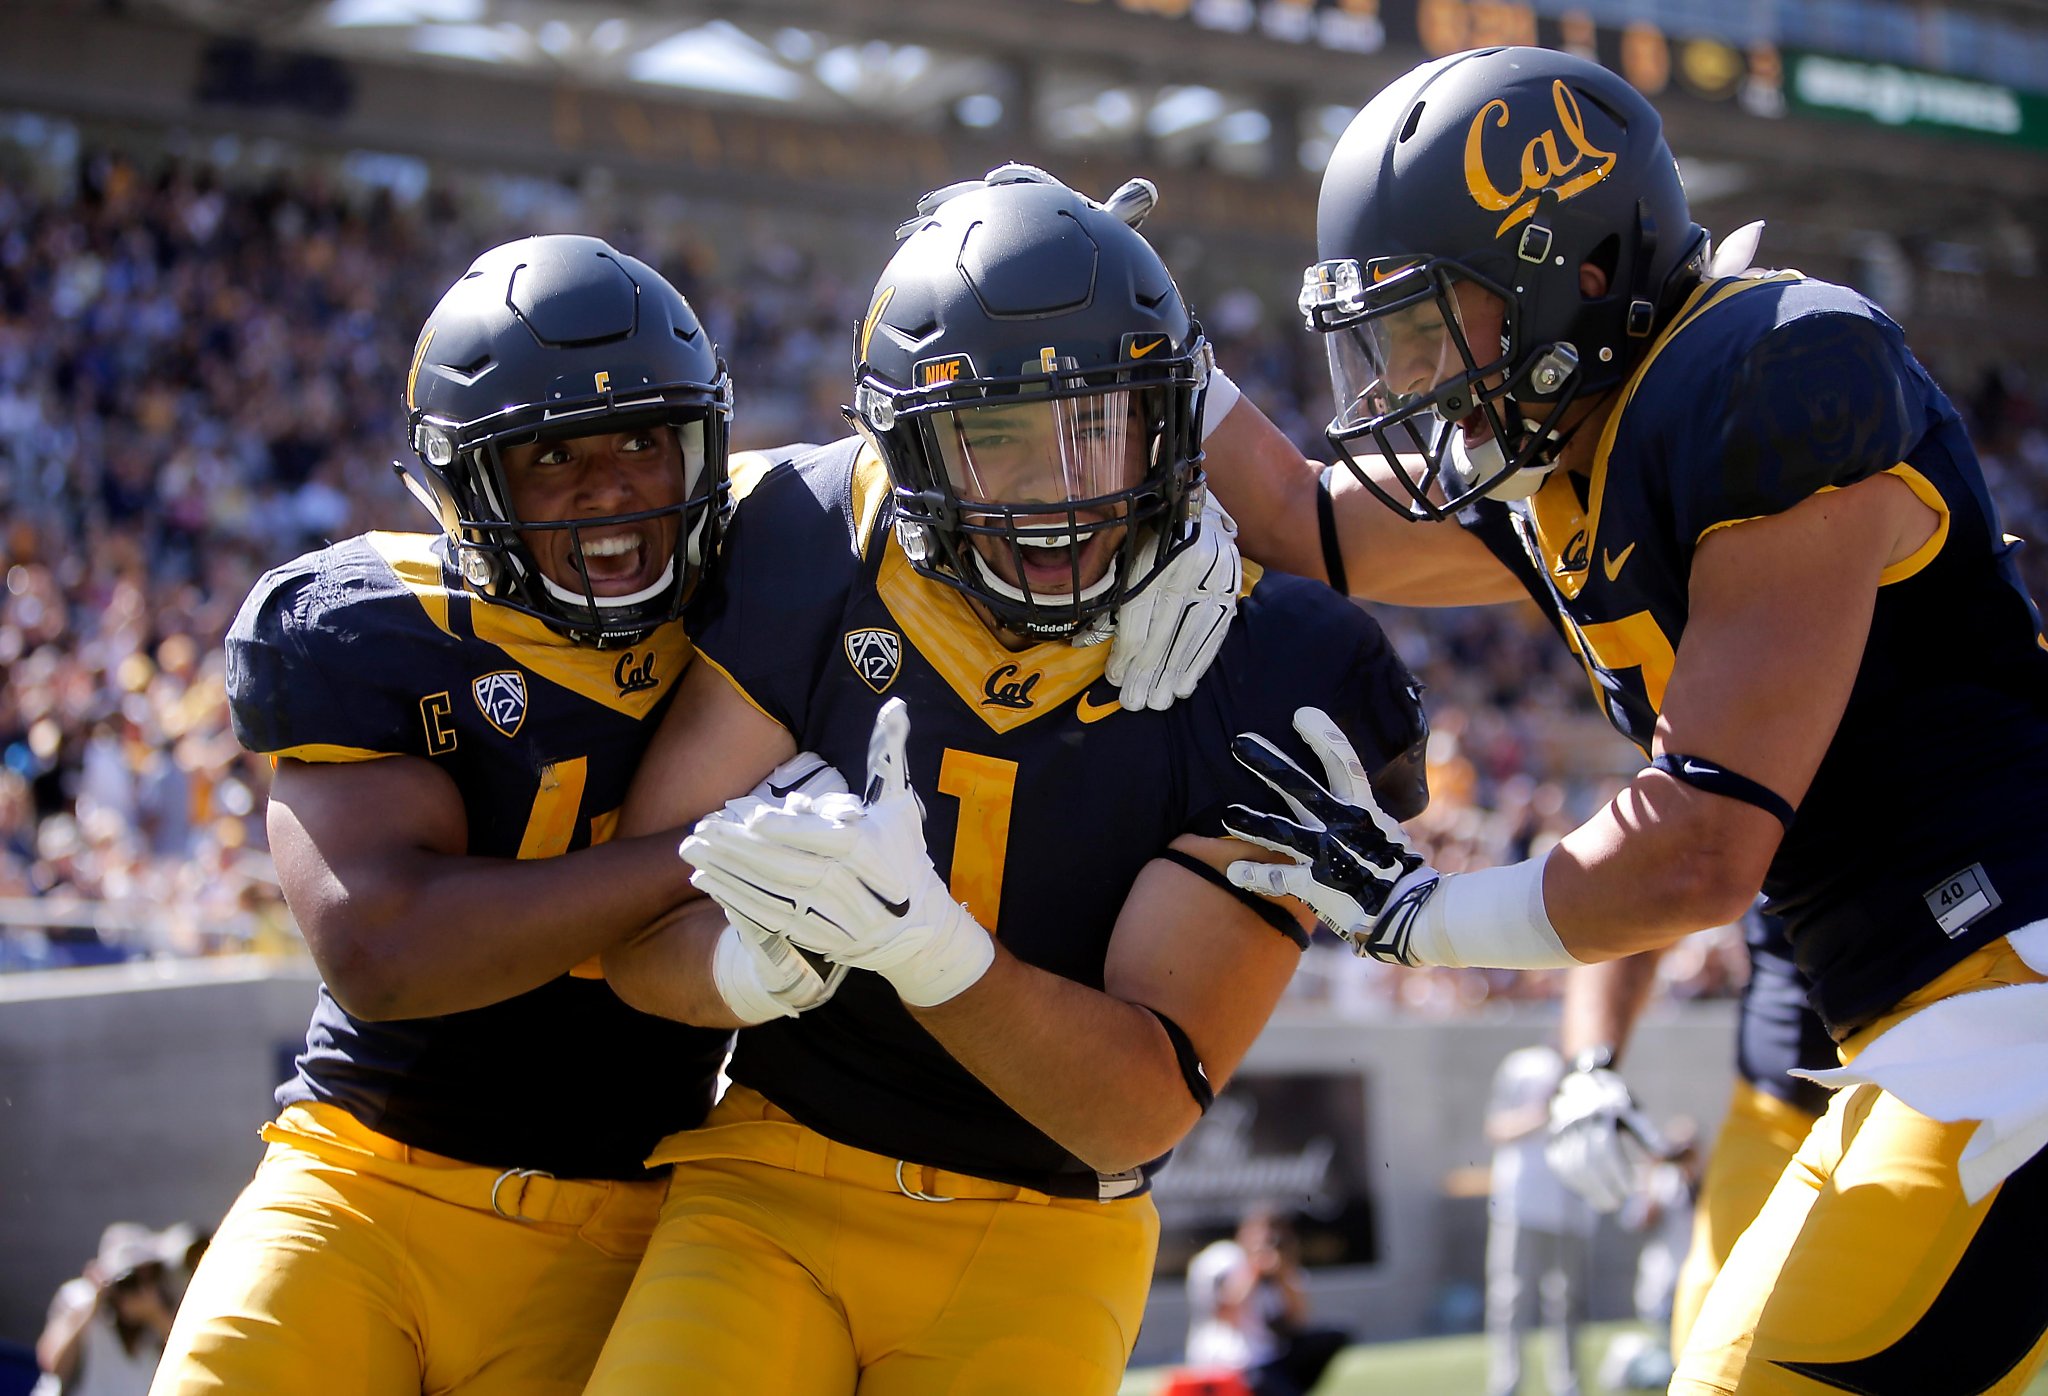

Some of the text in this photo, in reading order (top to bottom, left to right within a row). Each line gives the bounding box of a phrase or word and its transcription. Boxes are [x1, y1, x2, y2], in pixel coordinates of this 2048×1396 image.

[1464, 79, 1617, 239] Cal
[925, 360, 960, 386] NIKE
[1040, 346, 1058, 374] C
[848, 631, 898, 668] PAC
[863, 656, 890, 679] 12
[475, 673, 525, 714] PAC
[614, 652, 661, 698] Cal
[981, 664, 1041, 709] Cal
[419, 690, 457, 756] C
[492, 698, 520, 725] 12
[1940, 881, 1964, 906] 40
